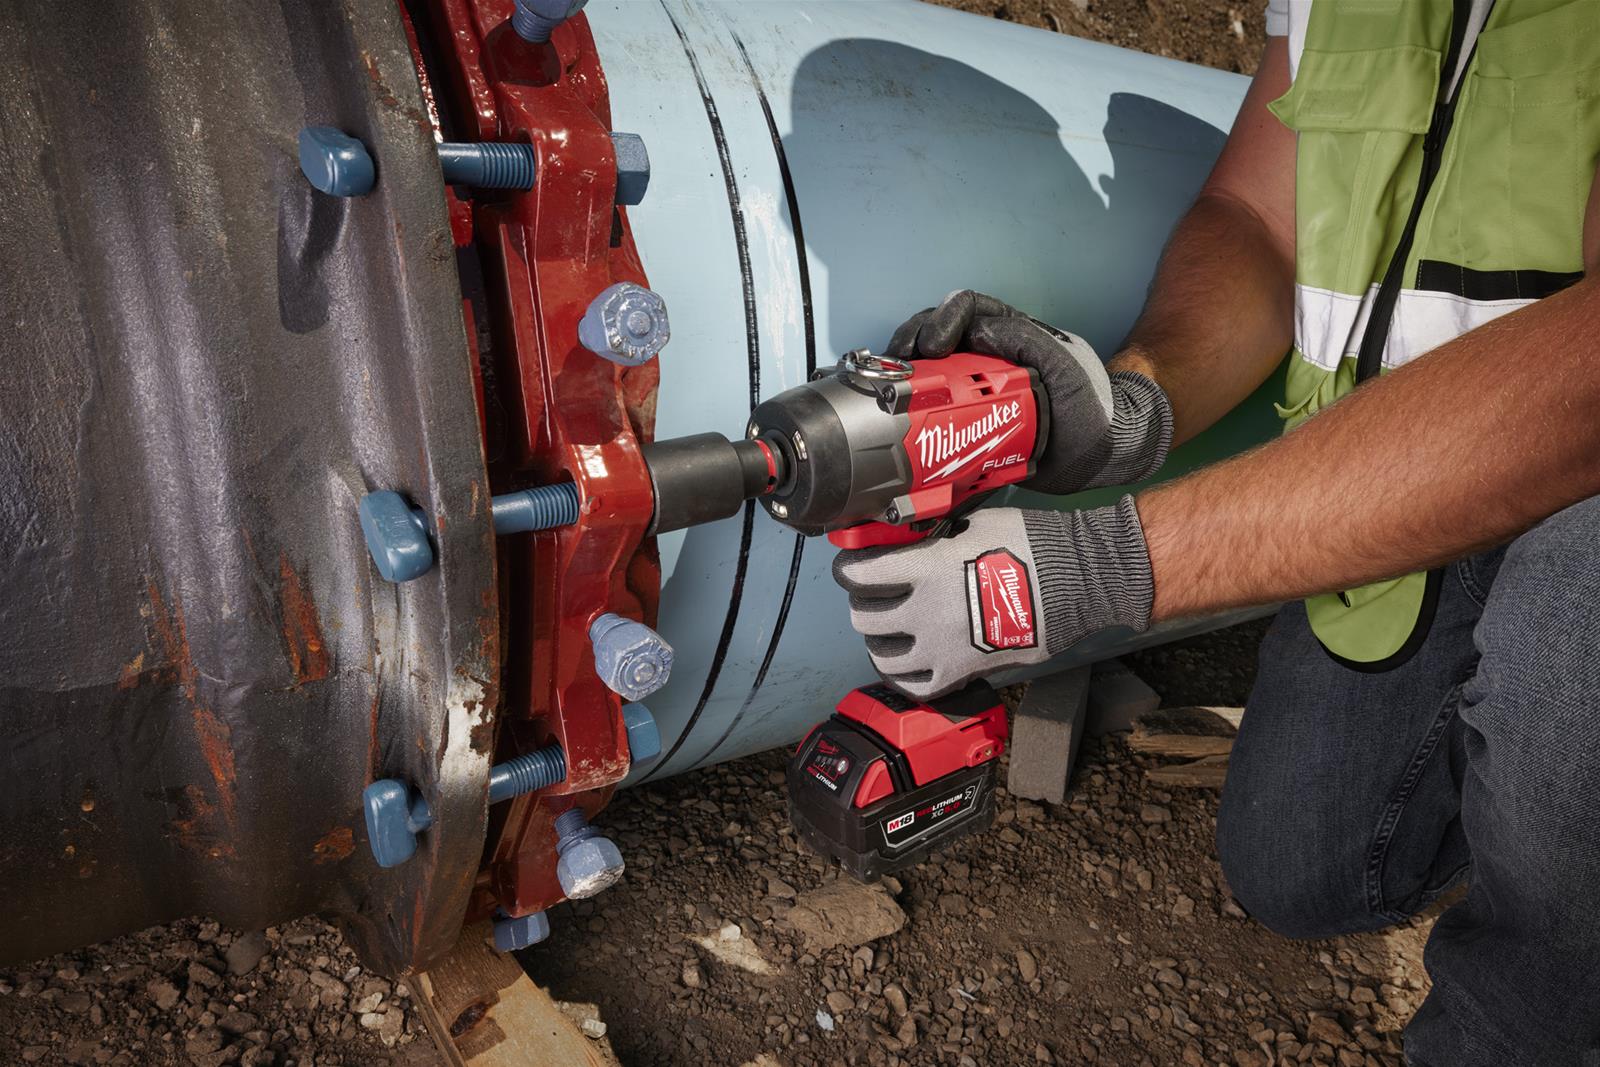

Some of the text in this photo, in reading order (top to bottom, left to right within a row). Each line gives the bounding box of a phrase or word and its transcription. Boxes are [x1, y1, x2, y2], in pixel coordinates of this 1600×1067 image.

[915, 400, 1021, 468] Milwaukee
[982, 453, 1025, 471] FUEL
[999, 563, 1029, 628] Milwaukee
[889, 813, 913, 832] M18
